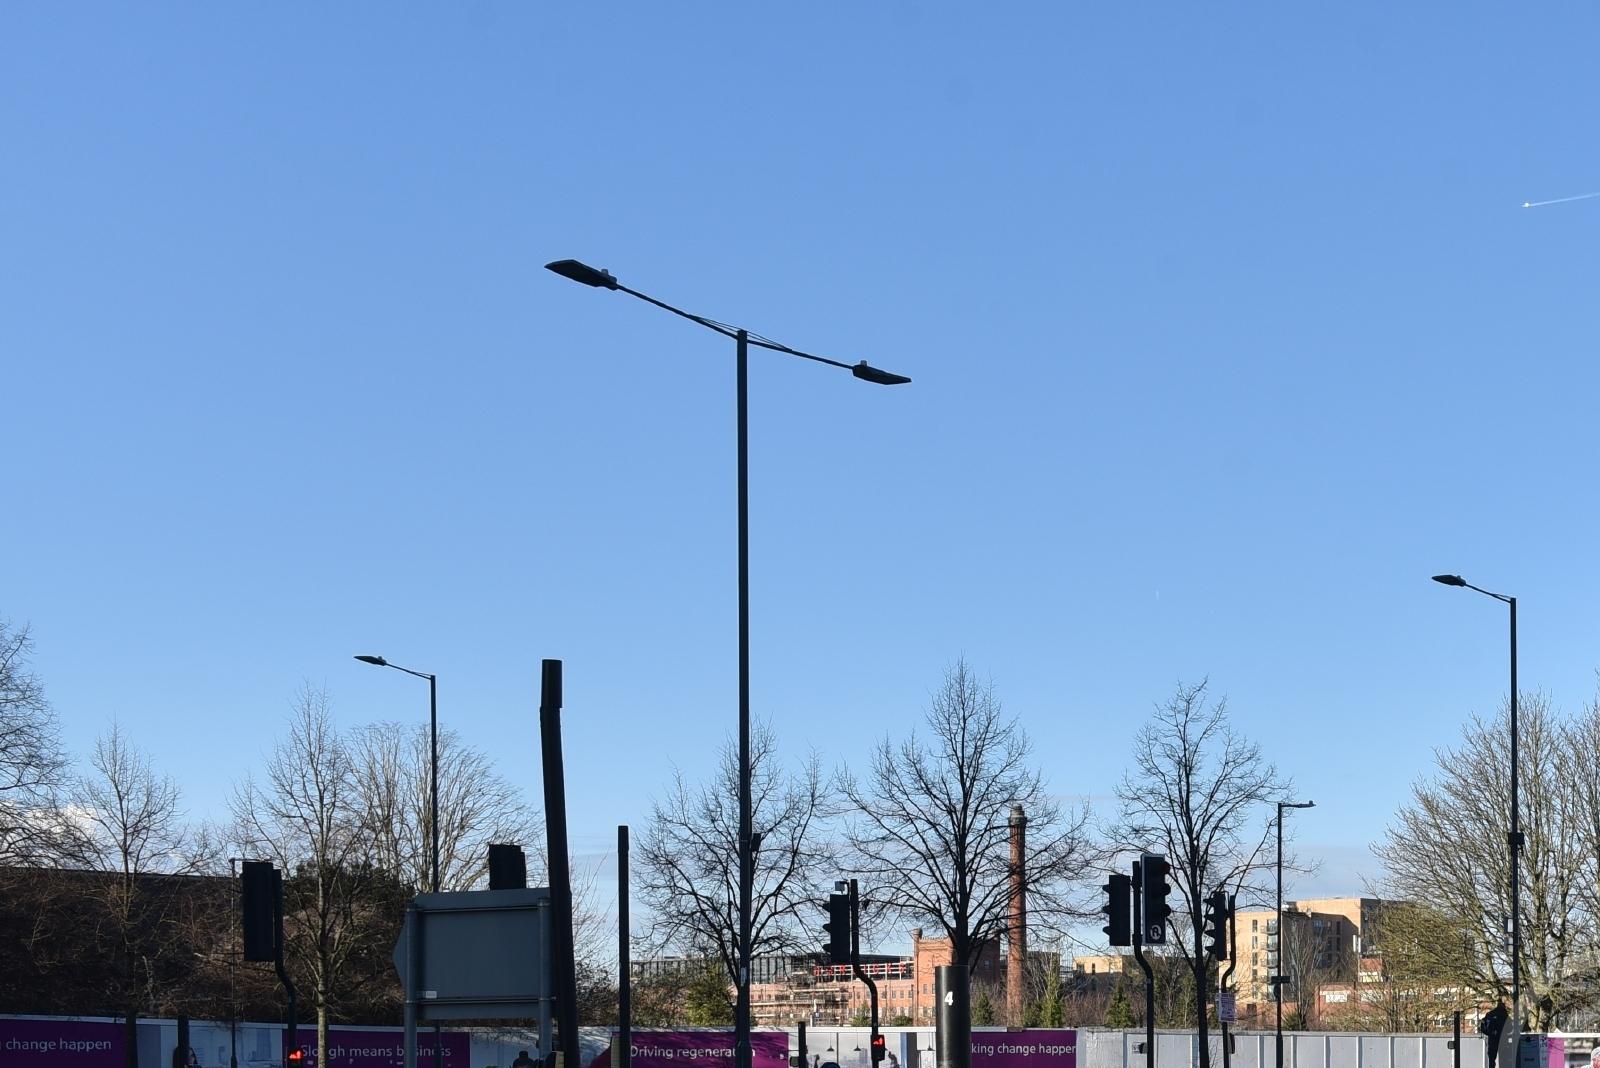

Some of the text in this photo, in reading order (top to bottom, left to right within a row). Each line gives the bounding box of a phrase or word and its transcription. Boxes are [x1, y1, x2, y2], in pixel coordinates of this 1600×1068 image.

[944, 991, 954, 1006] 4
[5, 1037, 112, 1053] change happen
[301, 1044, 452, 1060] Slogh means bsinss
[630, 1044, 674, 1060] Driving
[971, 1042, 994, 1056] king
[997, 1043, 1036, 1056] change
